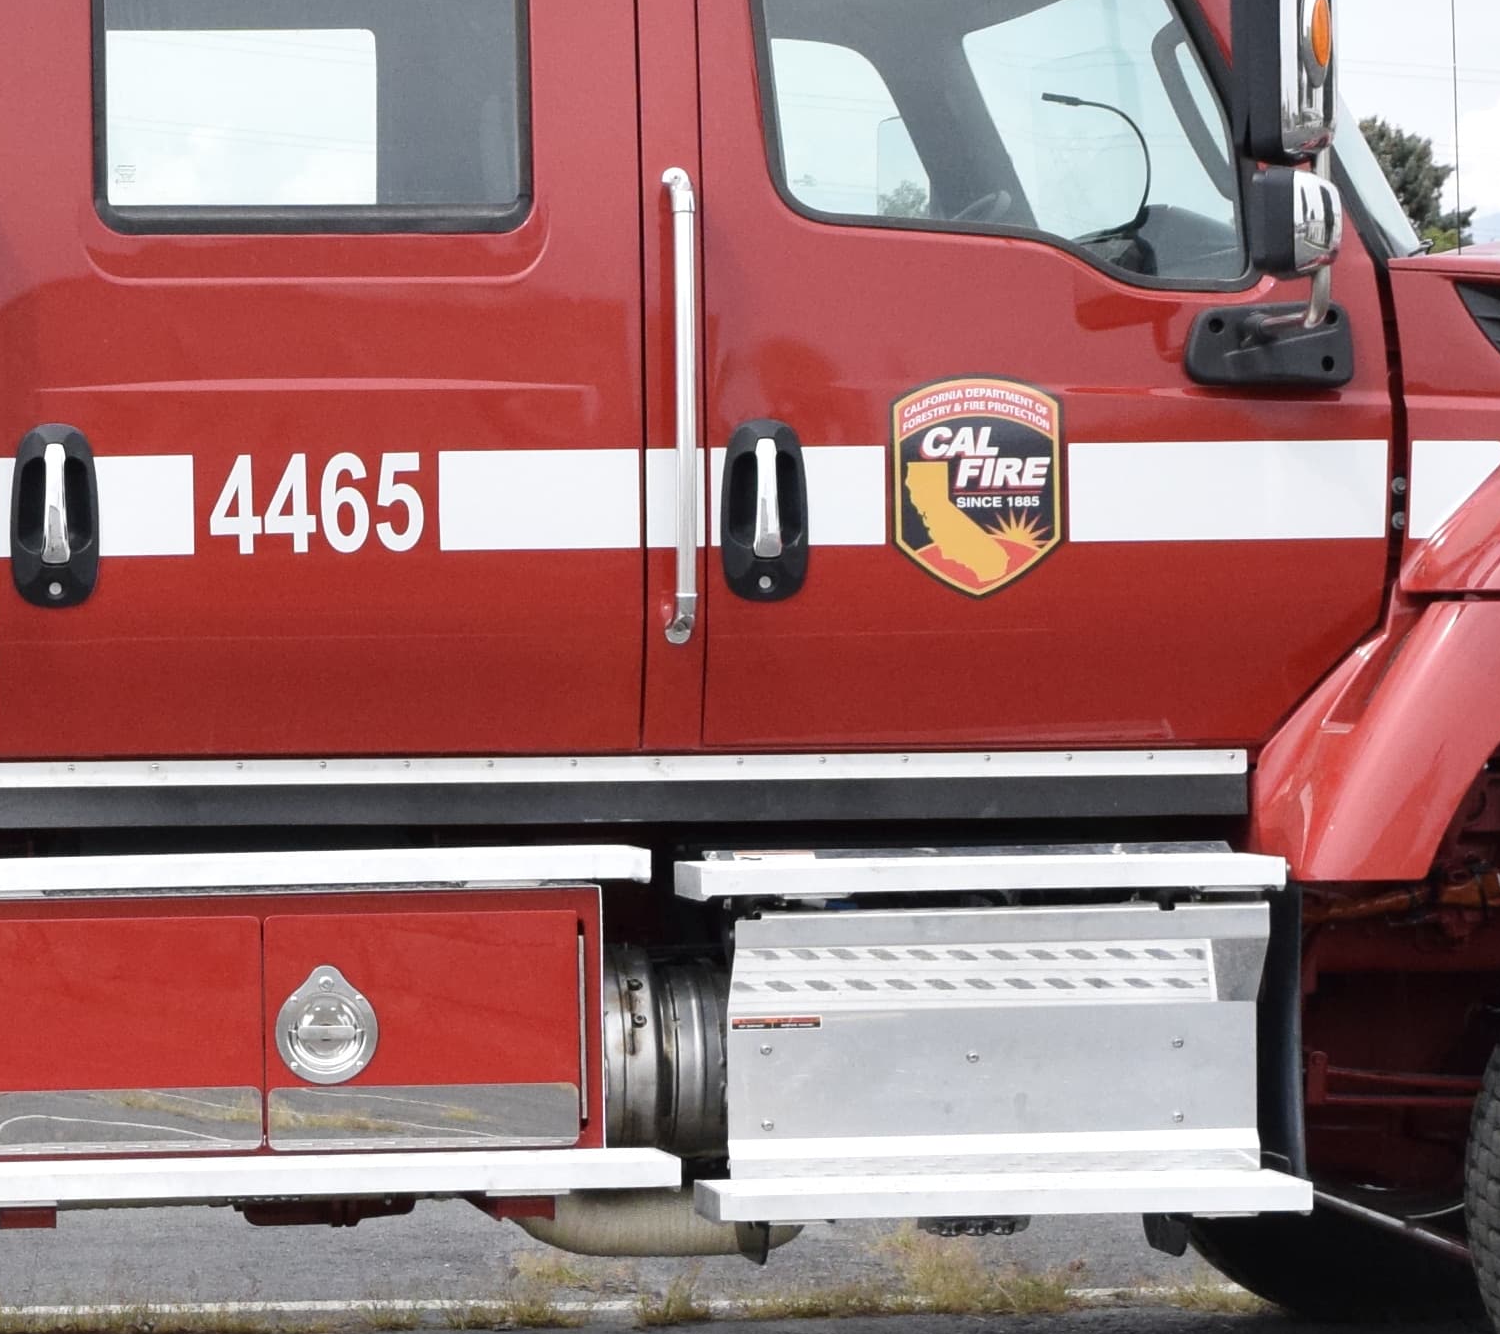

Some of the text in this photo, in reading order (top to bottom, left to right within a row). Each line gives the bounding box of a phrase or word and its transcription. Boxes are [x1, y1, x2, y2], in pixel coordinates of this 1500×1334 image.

[902, 400, 1050, 432] FORESTRY & FIRE PROTECTION
[904, 387, 1049, 418] CALIFORNIA DEPARTMENT OF
[921, 425, 1000, 458] CAL
[954, 456, 1051, 489] FIRE
[209, 451, 424, 555] 4465
[956, 495, 1040, 508] SINCE 1885
